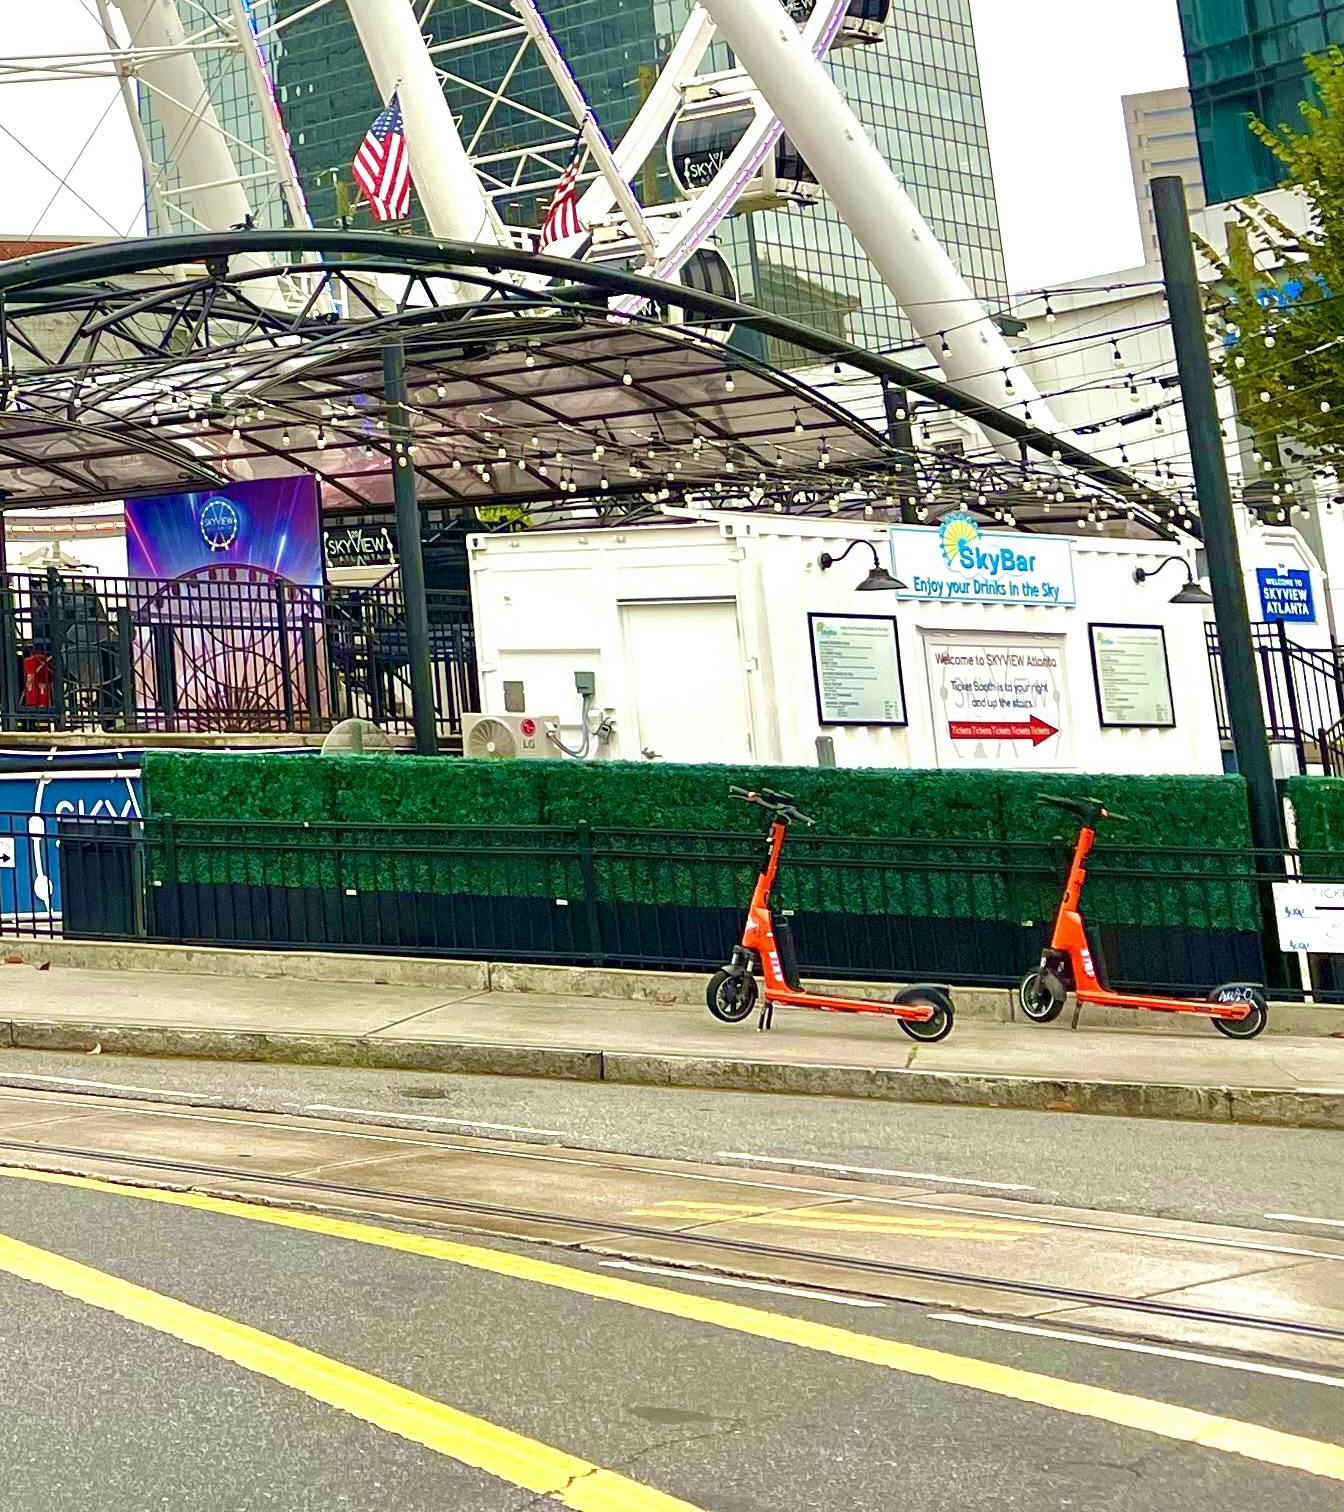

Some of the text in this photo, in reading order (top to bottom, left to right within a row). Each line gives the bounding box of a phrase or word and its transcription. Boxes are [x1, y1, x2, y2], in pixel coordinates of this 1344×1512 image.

[690, 150, 725, 178] SKYV
[328, 529, 384, 555] SKYVIEW
[959, 544, 1036, 576] SkyBar
[913, 576, 1060, 602] Enjoy your Drinks in the Sky
[1263, 587, 1307, 601] SKYVIEW
[1266, 601, 1310, 615] ATLANTA
[935, 651, 1057, 668] Welcome to SKYVIEW Atlanta
[987, 699, 997, 710] up
[523, 740, 536, 750] LG
